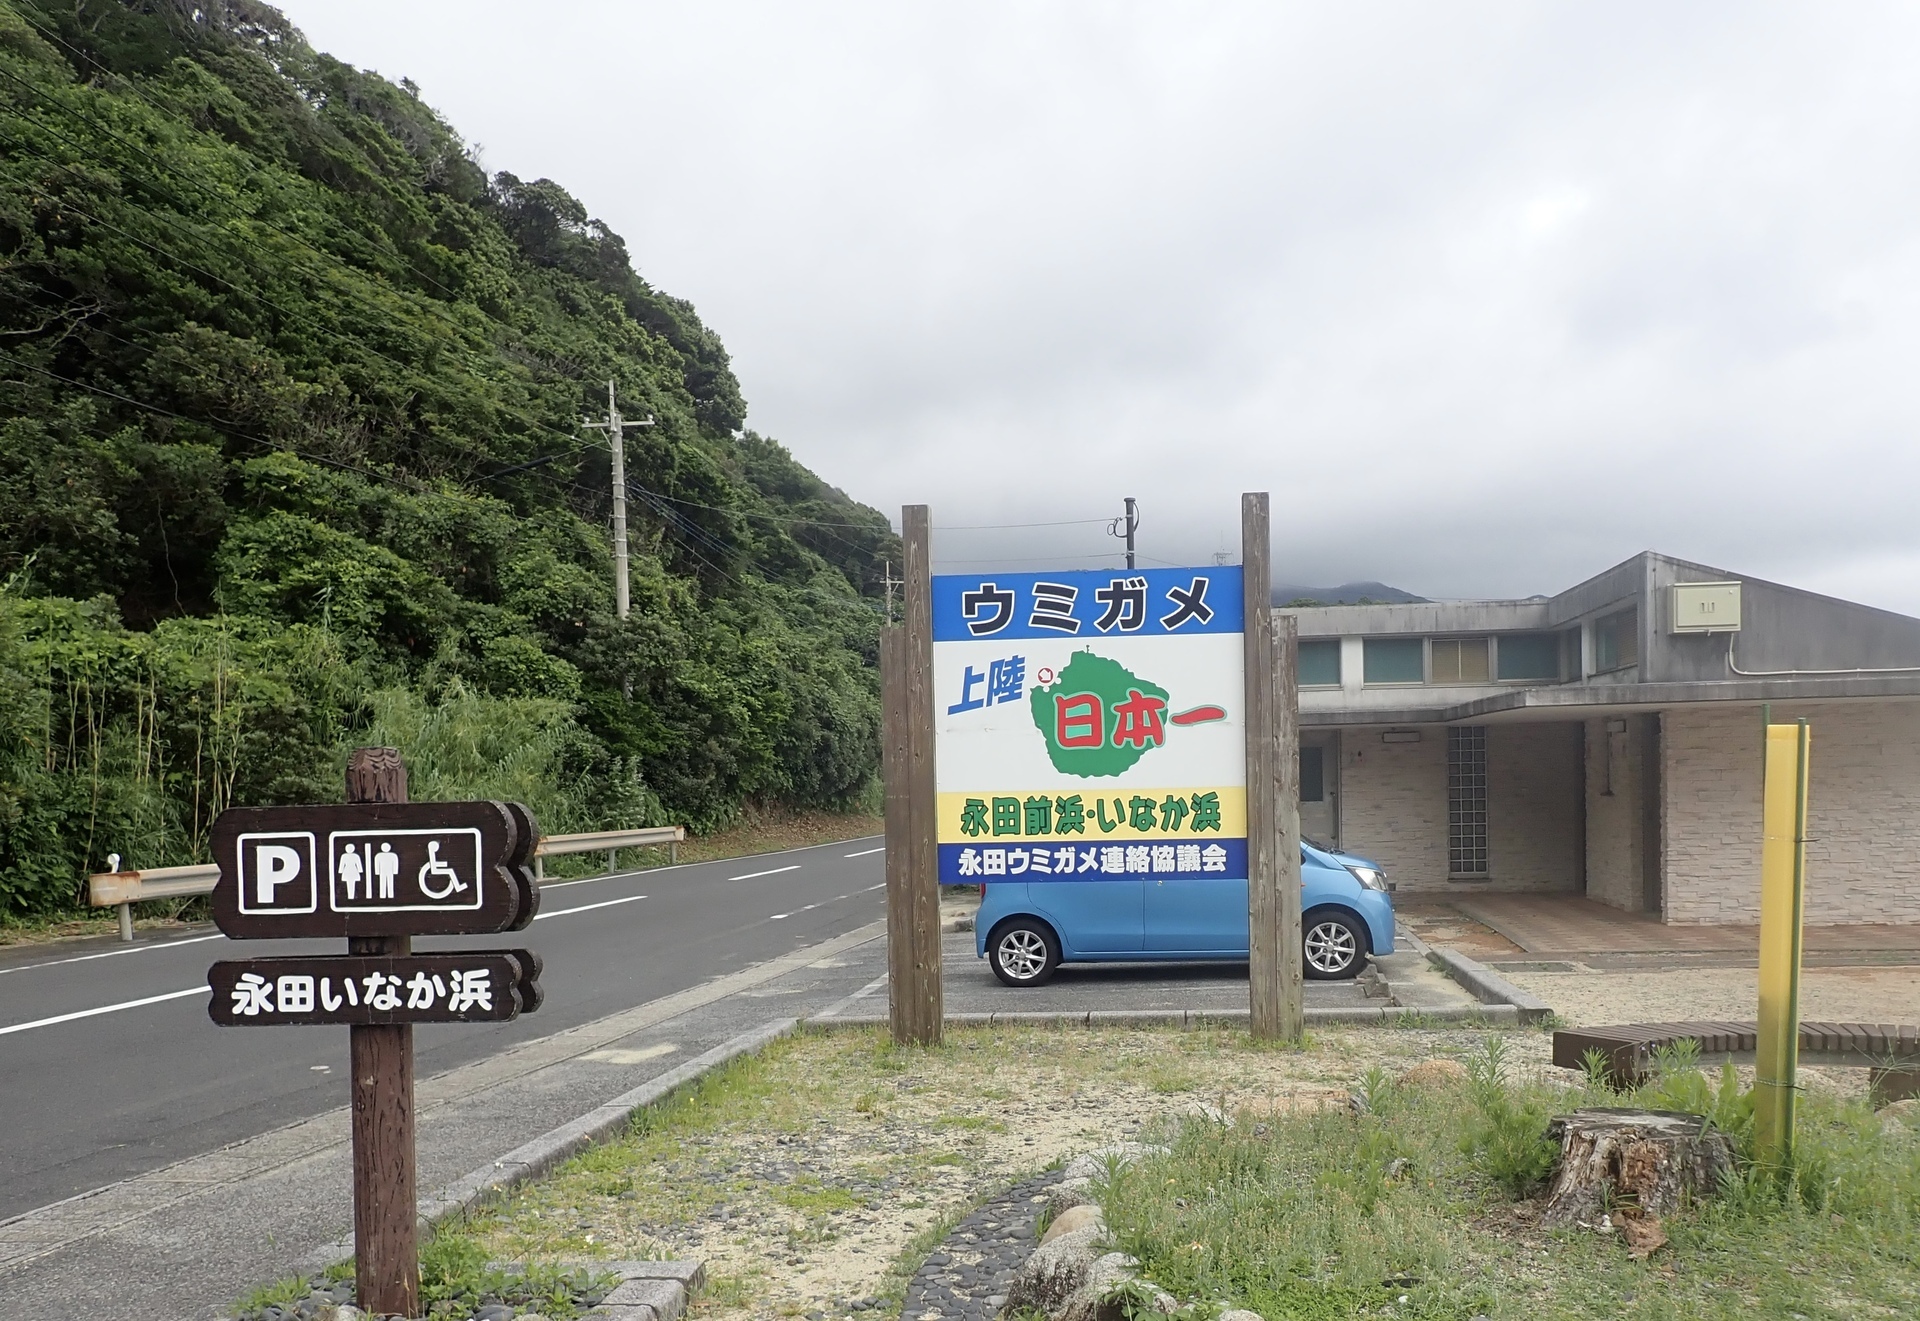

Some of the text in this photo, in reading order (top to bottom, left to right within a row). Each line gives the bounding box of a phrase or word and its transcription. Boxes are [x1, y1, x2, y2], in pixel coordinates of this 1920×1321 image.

[962, 576, 1215, 636] ウミガメ
[947, 655, 1026, 715] 上陸
[1054, 688, 1228, 749] 日本一
[256, 845, 301, 903] P
[958, 844, 1226, 876] 永田ウミガメ連絡協議会
[231, 968, 492, 1015] 永田いなか浜
